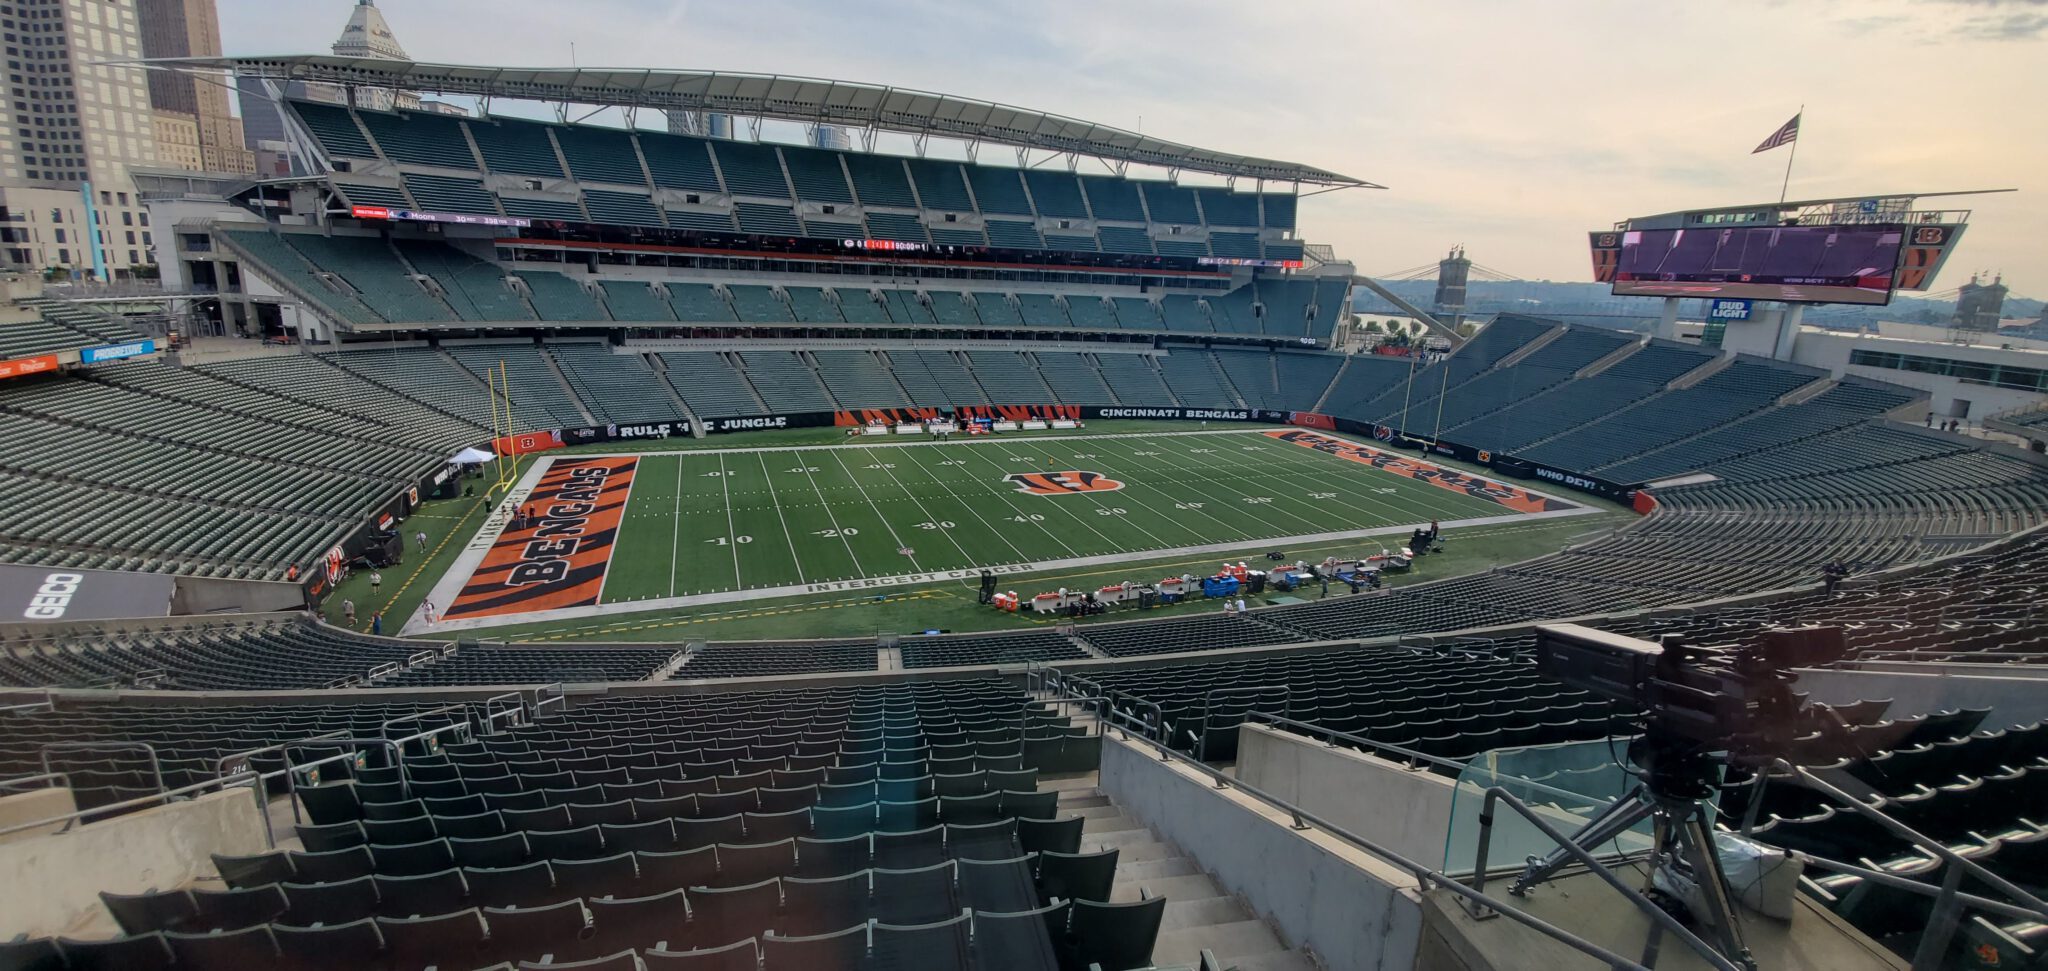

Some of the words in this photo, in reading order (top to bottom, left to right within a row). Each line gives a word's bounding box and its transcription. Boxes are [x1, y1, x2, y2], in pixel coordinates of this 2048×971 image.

[1718, 301, 1745, 311] BUD
[1712, 309, 1749, 319] LIGHT
[93, 343, 144, 361] PROGRESSIVE
[19, 361, 47, 372] Paycor
[1100, 408, 1180, 417] CINCINNATI
[1185, 410, 1247, 419] BENGALS
[620, 423, 670, 437] RULE
[676, 421, 714, 432] TE
[721, 416, 787, 430] JUNGLE
[1292, 431, 1522, 500] BENGALS
[1536, 467, 1565, 482] WHO
[1565, 476, 1597, 490] DEY!
[1175, 501, 1204, 510] 40
[1095, 507, 1128, 516] 50
[1014, 513, 1045, 523] 40
[505, 466, 611, 586] BENGALS
[920, 520, 956, 530] 30
[820, 527, 859, 537] 20
[715, 535, 753, 546] 10
[807, 573, 936, 592] INTERCEPT
[24, 573, 84, 619] GEICO
[232, 764, 246, 775] 214
